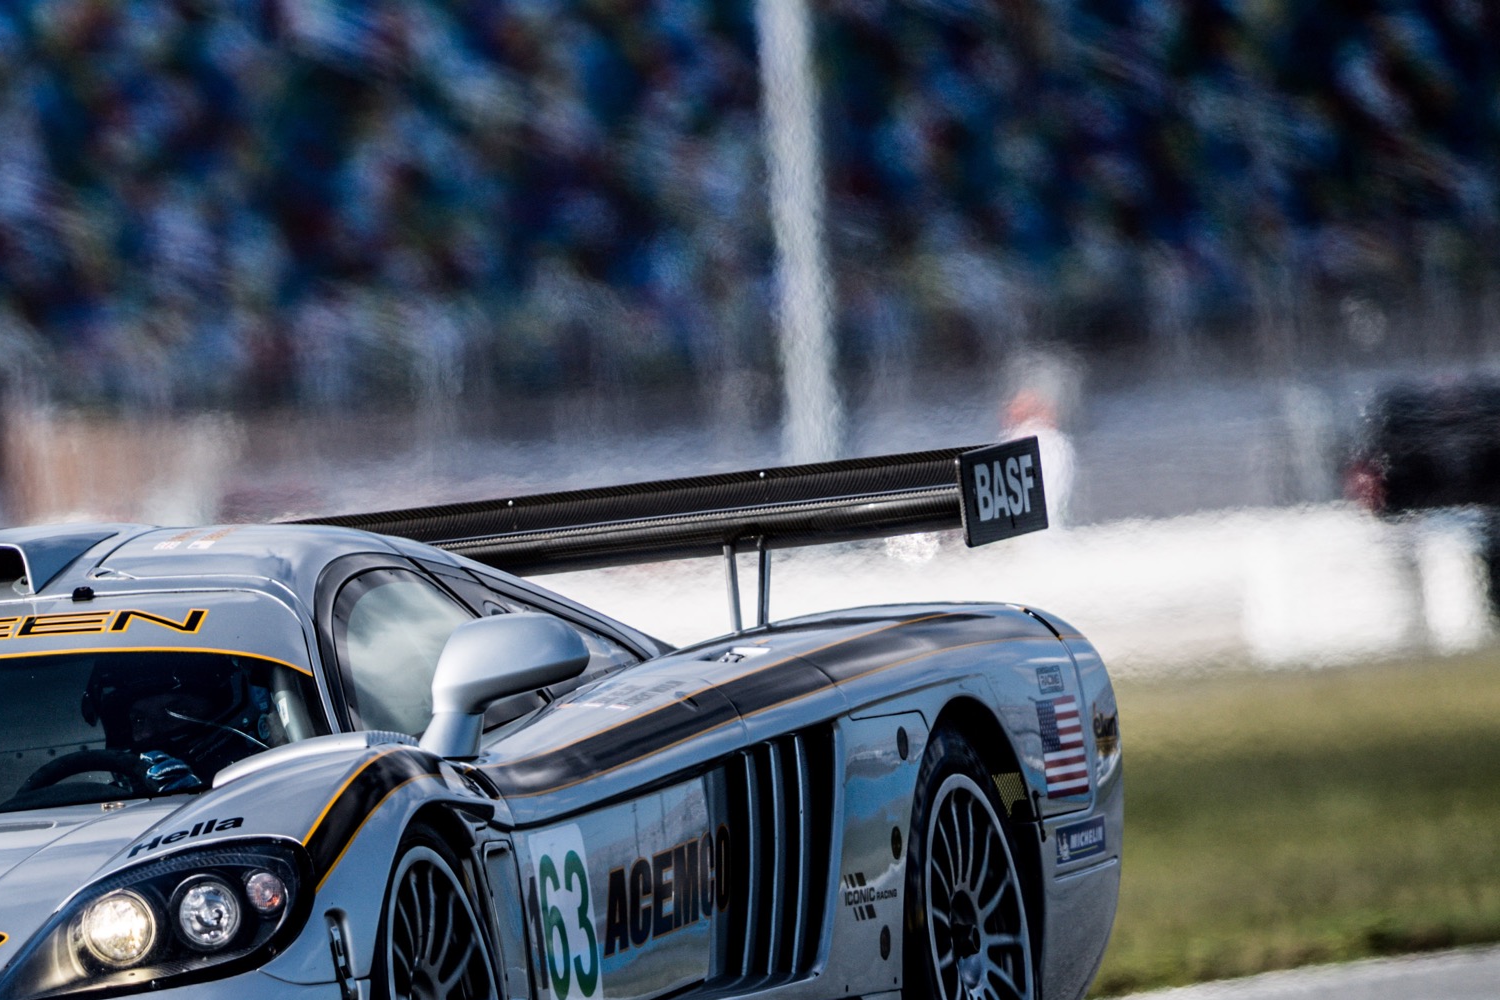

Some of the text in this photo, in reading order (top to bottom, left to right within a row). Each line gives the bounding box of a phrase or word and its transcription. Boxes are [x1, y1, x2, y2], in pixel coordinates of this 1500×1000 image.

[974, 454, 1034, 521] BASF
[126, 815, 245, 860] Hella
[603, 823, 731, 959] ACEMCO
[844, 886, 898, 907] ICONIC RACING
